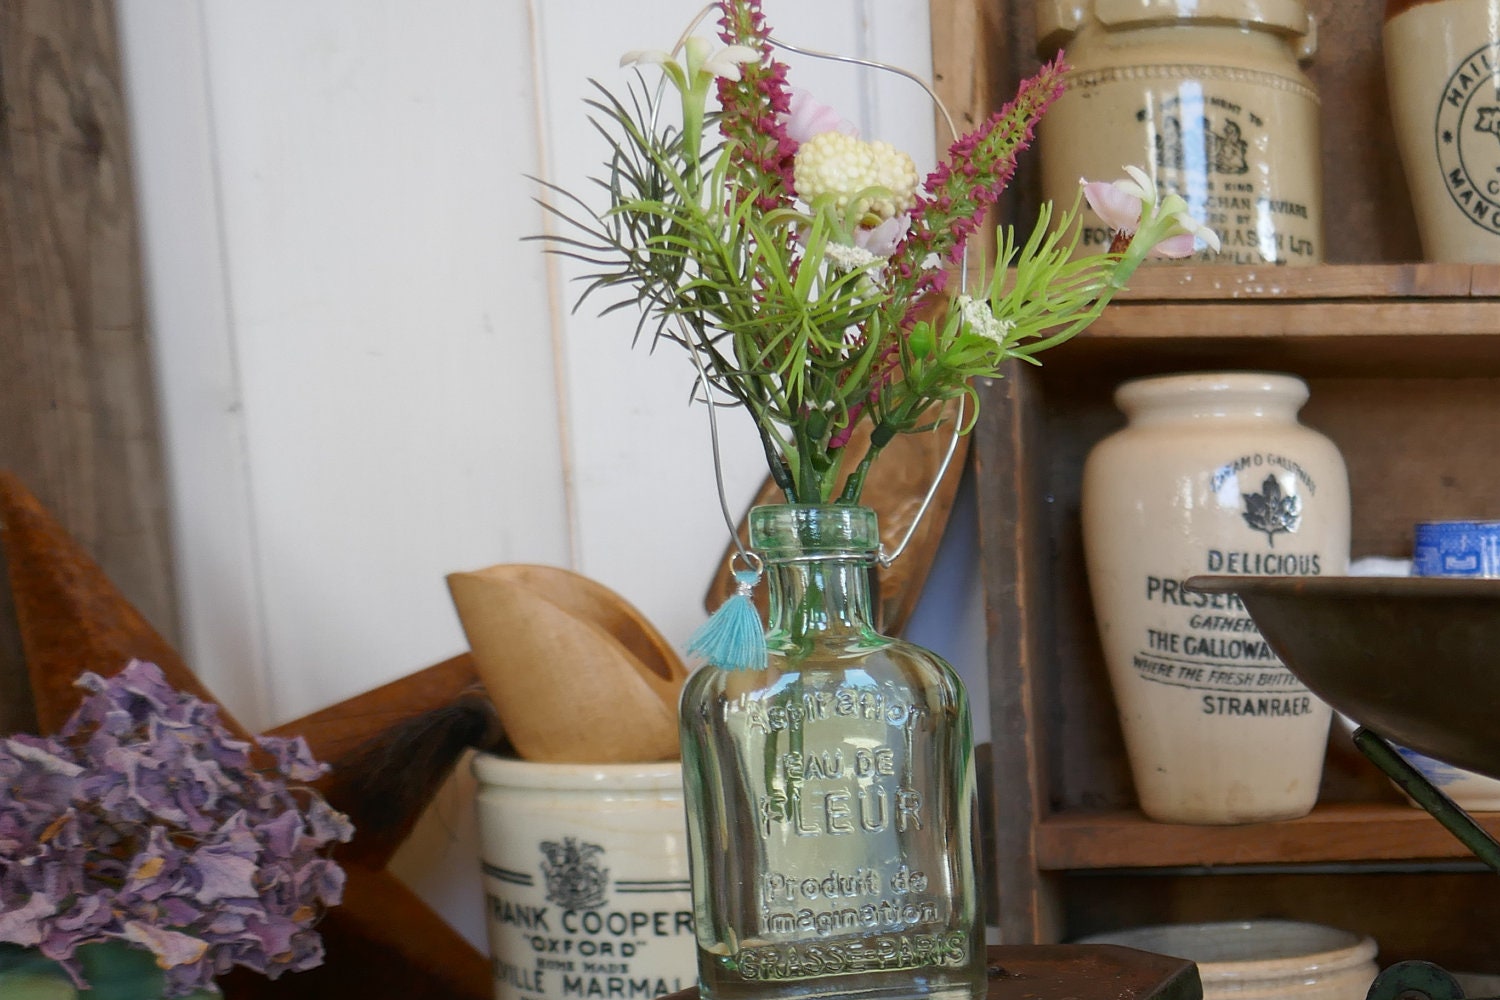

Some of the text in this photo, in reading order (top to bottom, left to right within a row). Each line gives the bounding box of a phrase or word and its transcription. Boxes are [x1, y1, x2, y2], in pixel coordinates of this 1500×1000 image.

[1208, 549, 1321, 576] DELICIOUS
[1147, 575, 1245, 611] PRESER
[1190, 614, 1259, 633] GATHER
[1148, 630, 1278, 661] THE GALLOWA
[1133, 656, 1173, 677] WHERE
[1178, 666, 1203, 682] THE
[1207, 670, 1254, 686] FRESH
[782, 747, 895, 783] EAU DE
[760, 784, 923, 840] FLEUR
[764, 864, 929, 902] Produit de
[561, 910, 695, 937] COOPER
[760, 901, 942, 936] imagination
[583, 962, 630, 974] MADE
